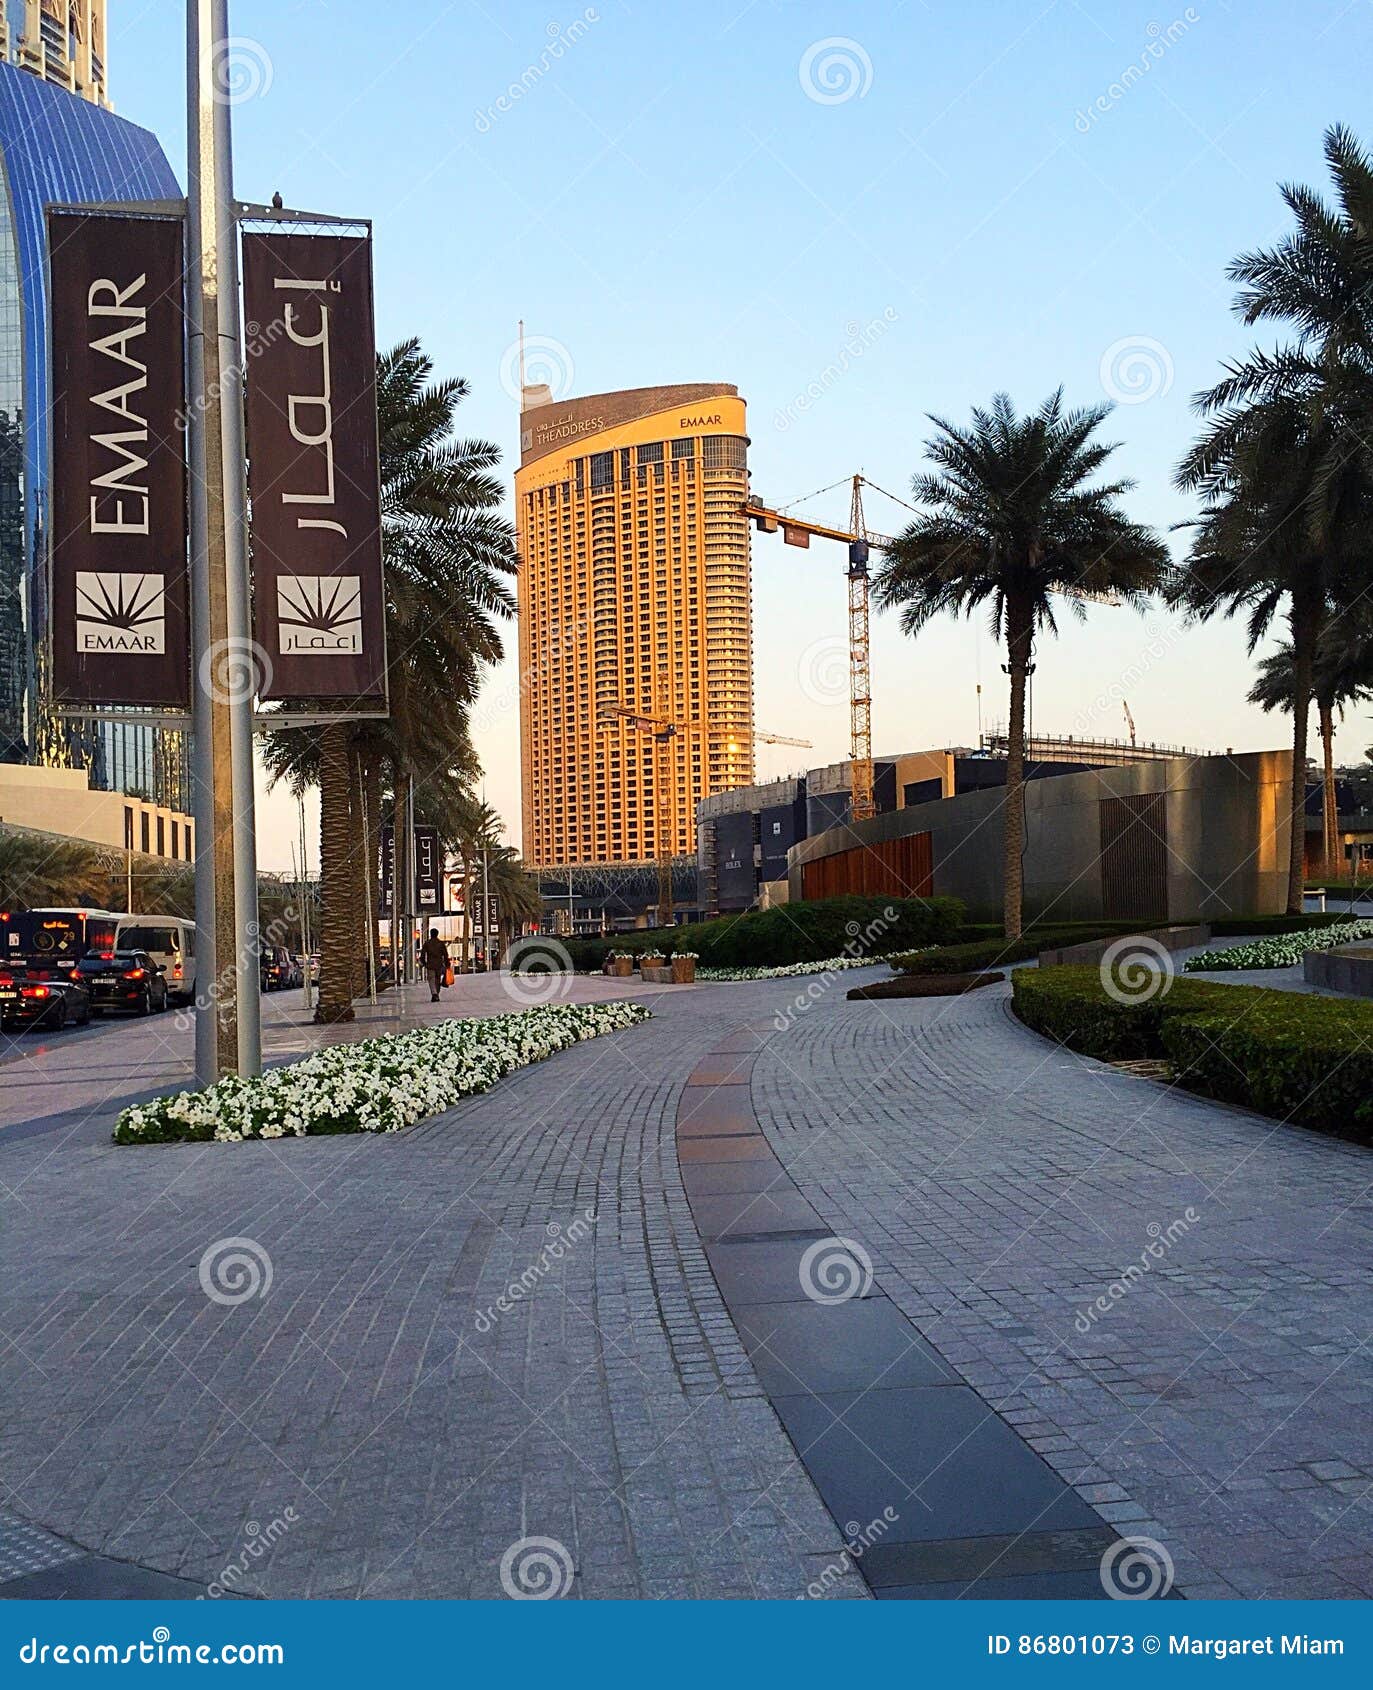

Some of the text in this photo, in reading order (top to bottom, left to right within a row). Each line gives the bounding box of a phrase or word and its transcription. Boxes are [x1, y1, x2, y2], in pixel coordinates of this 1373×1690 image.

[88, 273, 149, 535] EMAAR
[274, 278, 348, 539] إعمار
[680, 414, 722, 429] EMAAR
[84, 634, 157, 651] EMAAR
[286, 634, 356, 653] إعمار
